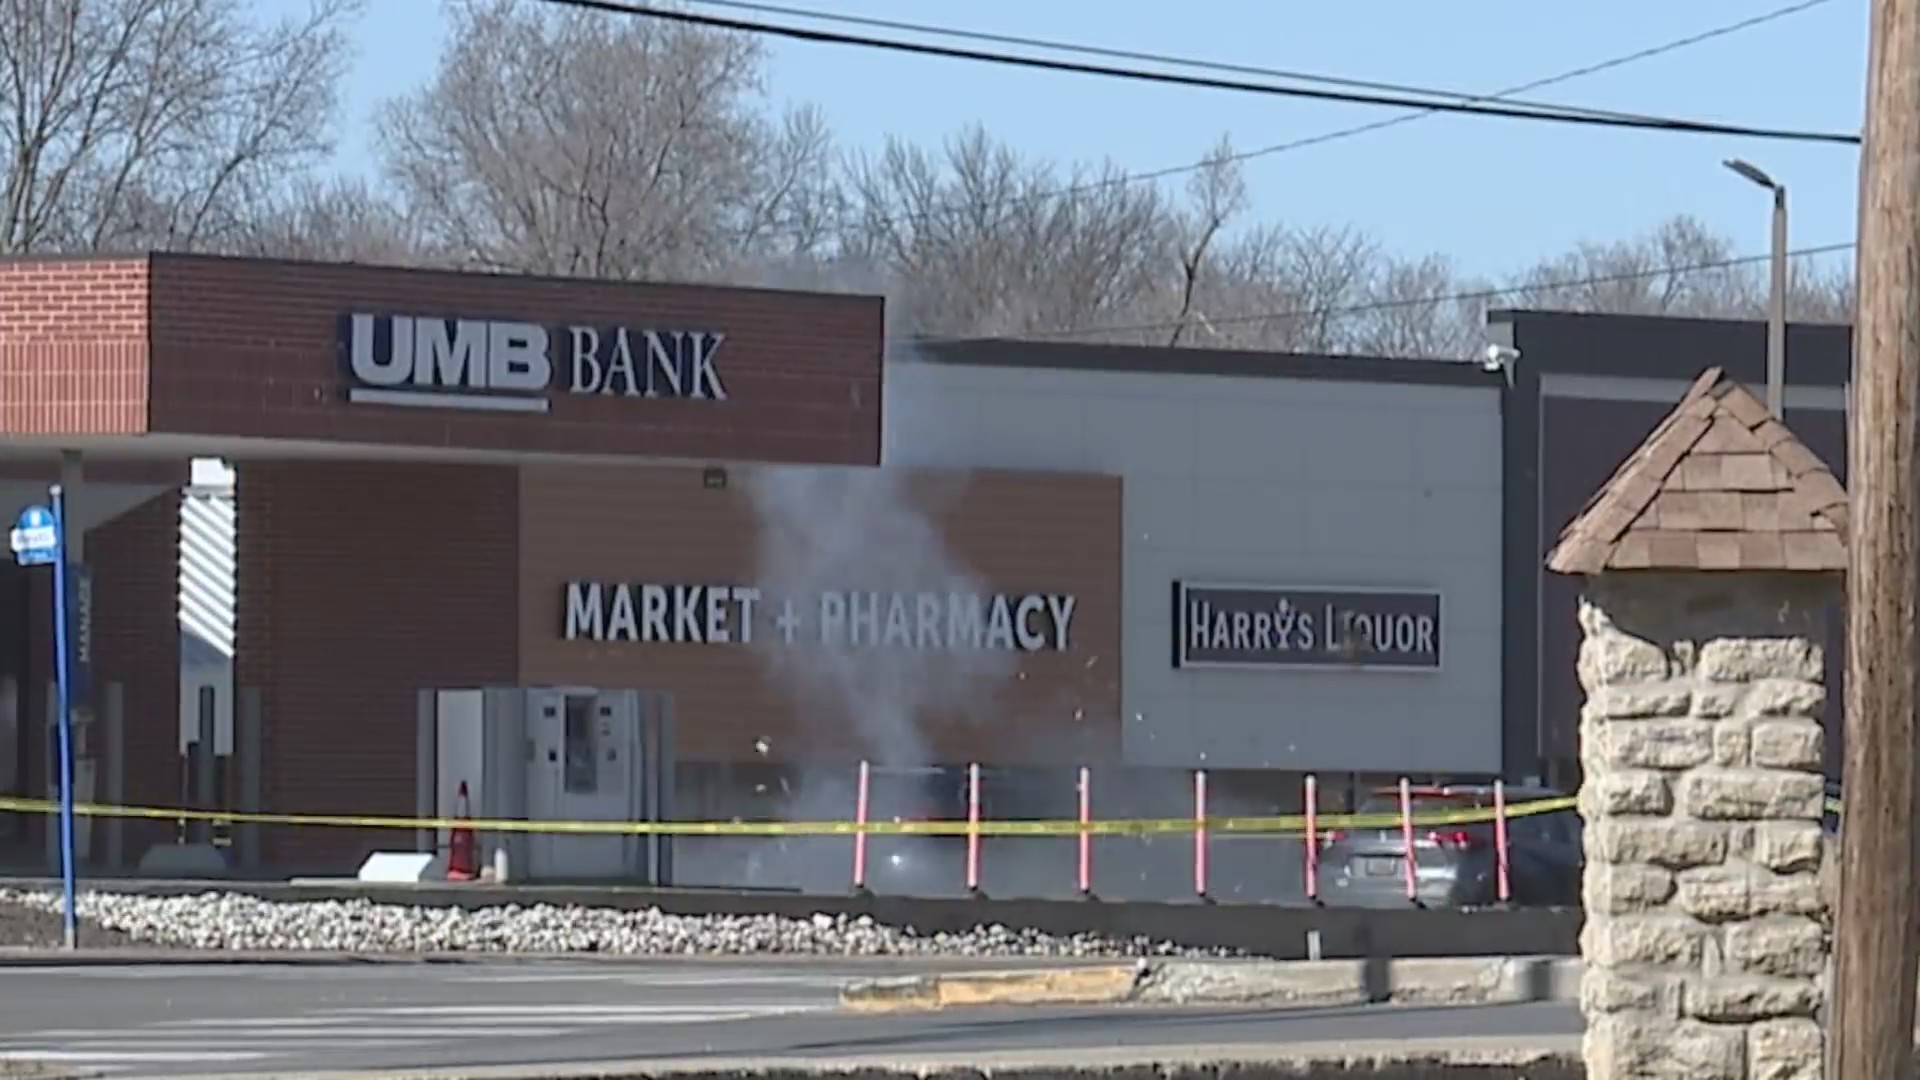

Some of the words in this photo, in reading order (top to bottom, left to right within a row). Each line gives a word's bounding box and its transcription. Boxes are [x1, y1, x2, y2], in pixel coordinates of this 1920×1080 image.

[350, 314, 551, 390] UMB
[569, 326, 727, 400] BANK
[563, 582, 760, 643] MARKET
[819, 592, 1076, 650] PHARMACY
